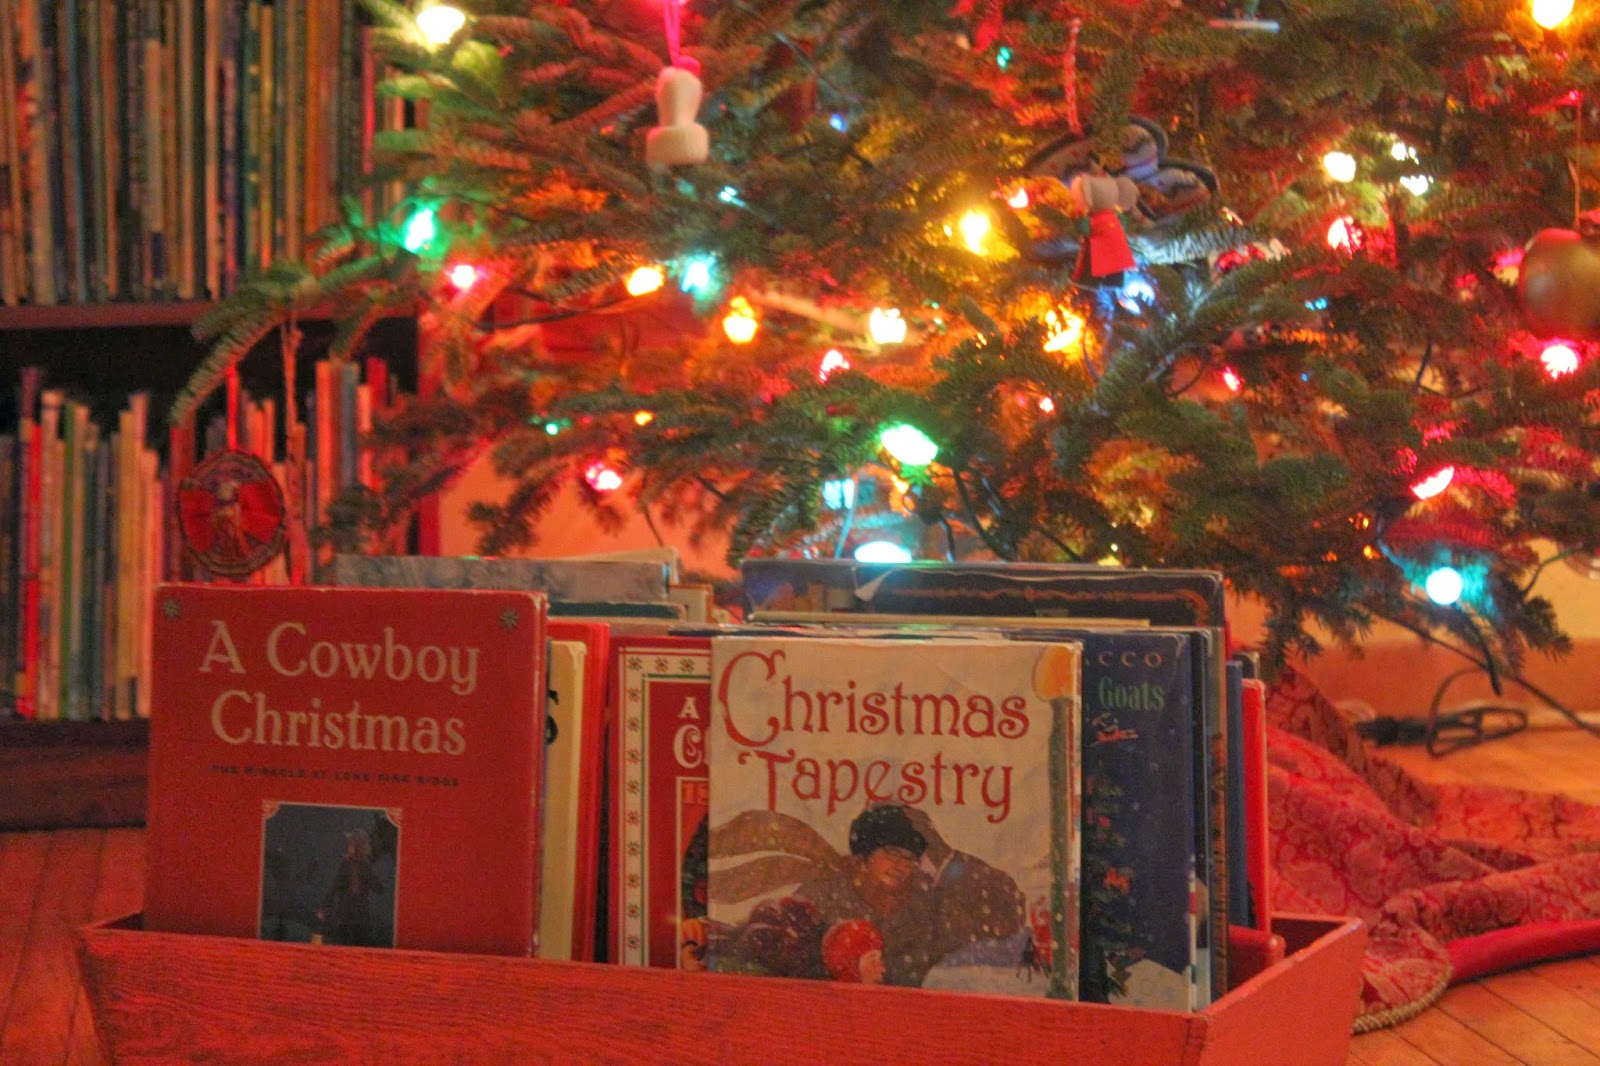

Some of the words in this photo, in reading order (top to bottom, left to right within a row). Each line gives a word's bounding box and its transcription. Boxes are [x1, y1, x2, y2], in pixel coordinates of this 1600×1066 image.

[200, 620, 246, 675] A
[266, 622, 480, 696] Cowboy
[1085, 650, 1163, 669] CCO
[210, 690, 466, 756] Christmas
[677, 696, 700, 719] A
[718, 650, 1030, 747] Christmas
[738, 748, 1013, 824] Tapestry
